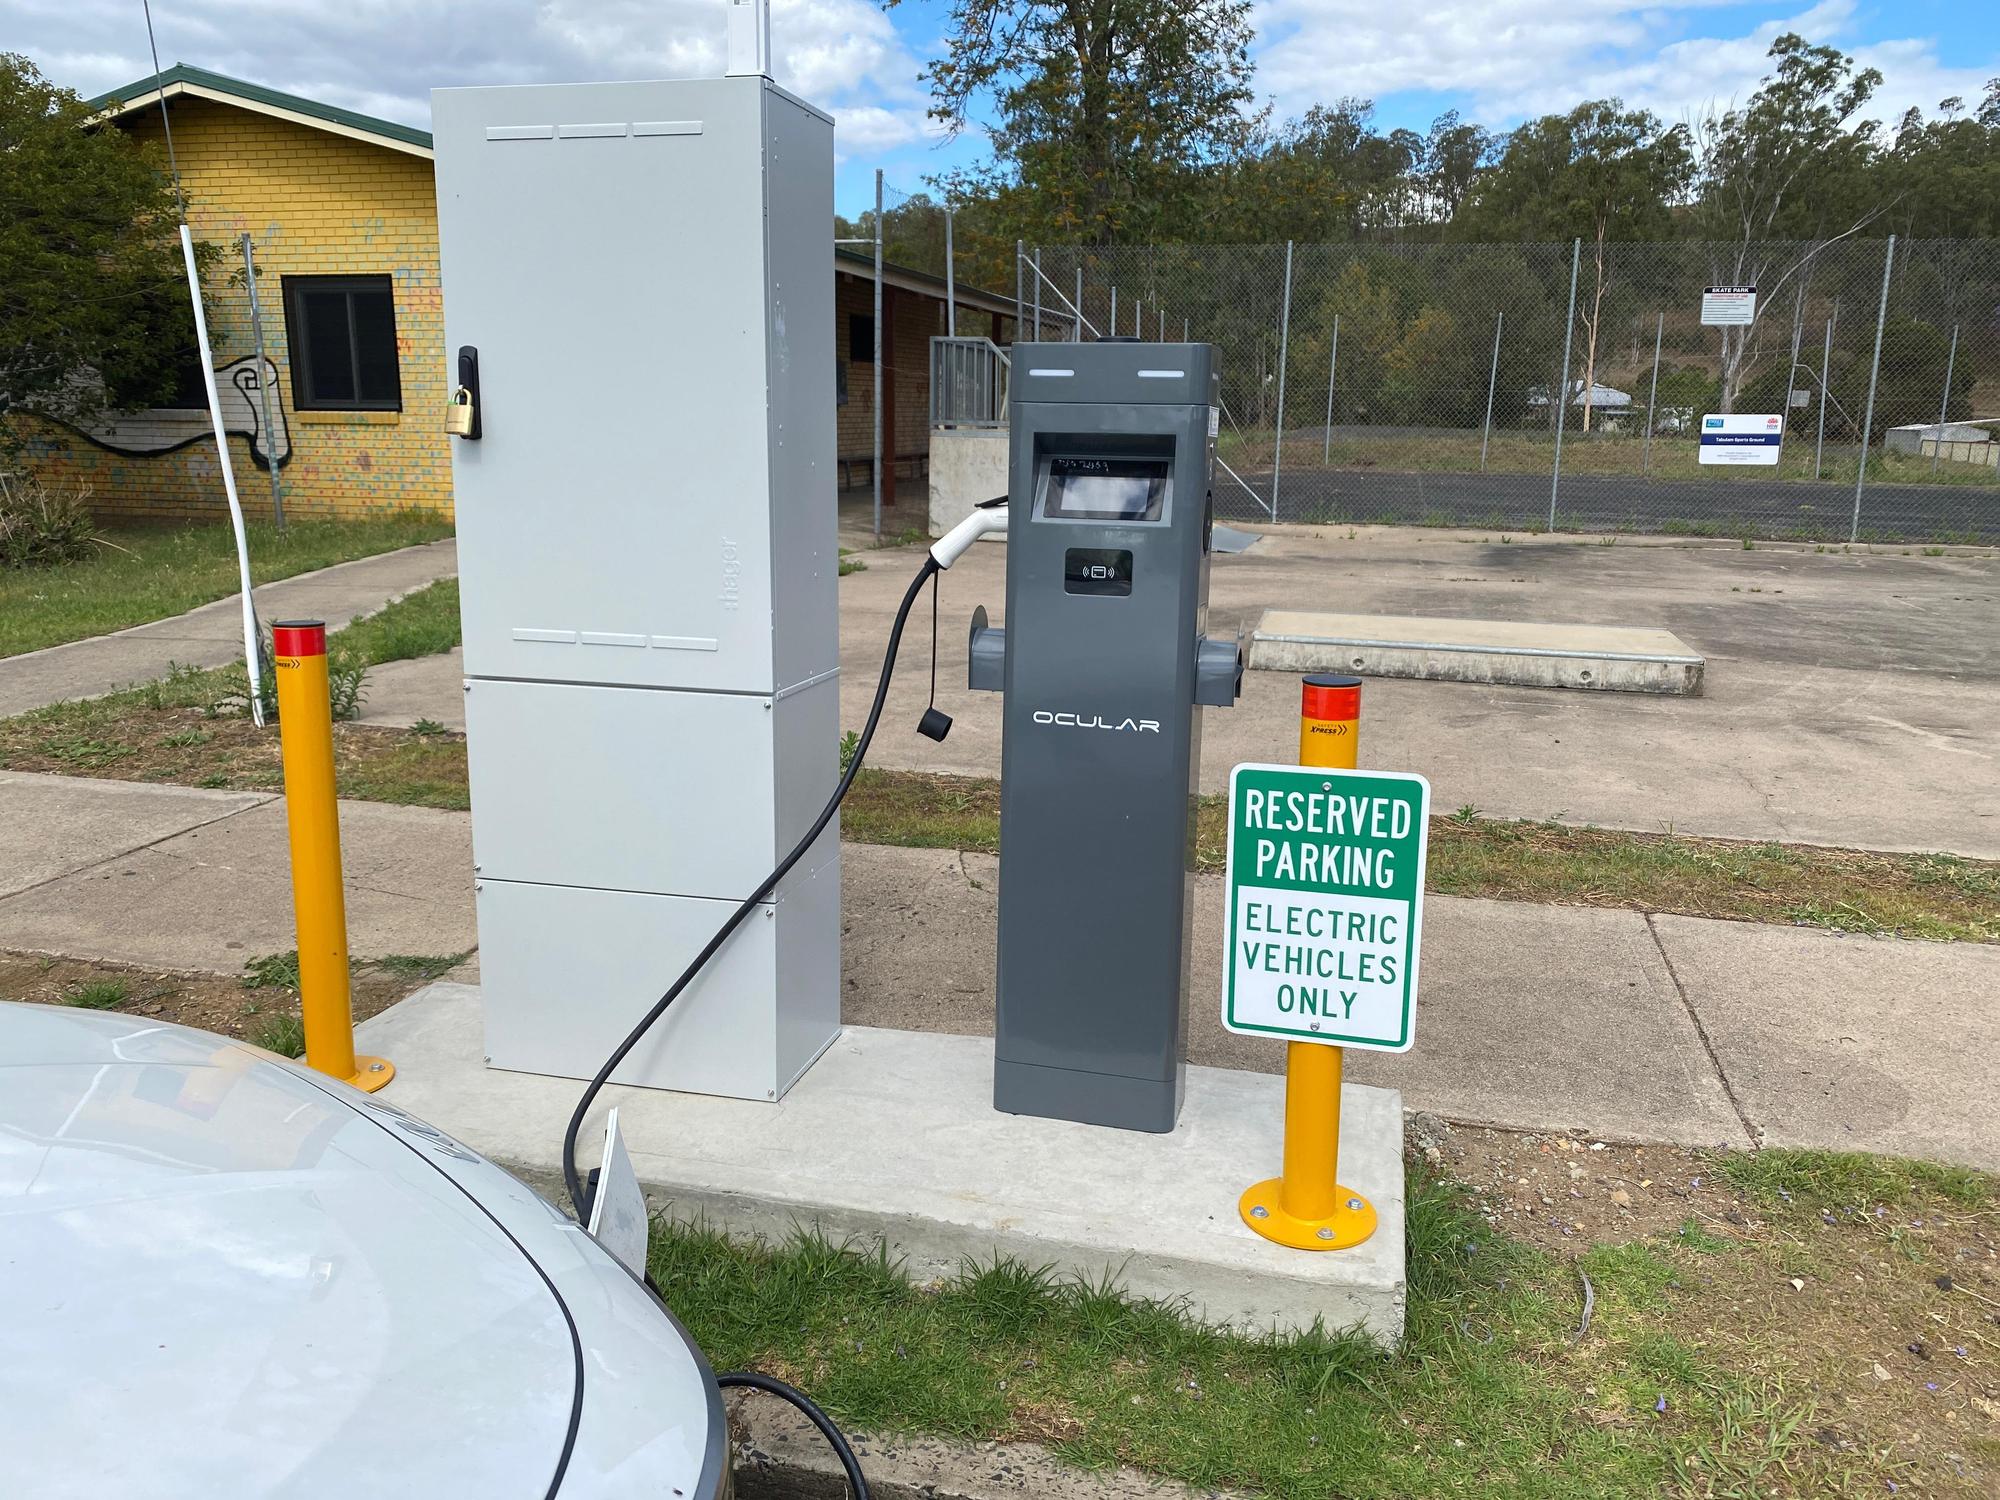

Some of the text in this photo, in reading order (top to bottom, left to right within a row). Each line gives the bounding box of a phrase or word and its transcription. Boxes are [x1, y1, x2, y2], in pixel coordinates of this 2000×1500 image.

[1033, 711, 1160, 733] OCULAR
[1245, 788, 1411, 839] RESERVED
[1256, 839, 1395, 889] PARKING
[1246, 902, 1398, 945] ELECTRIC
[1243, 941, 1397, 985] VEHICLES
[1277, 984, 1358, 1019] ONLY
